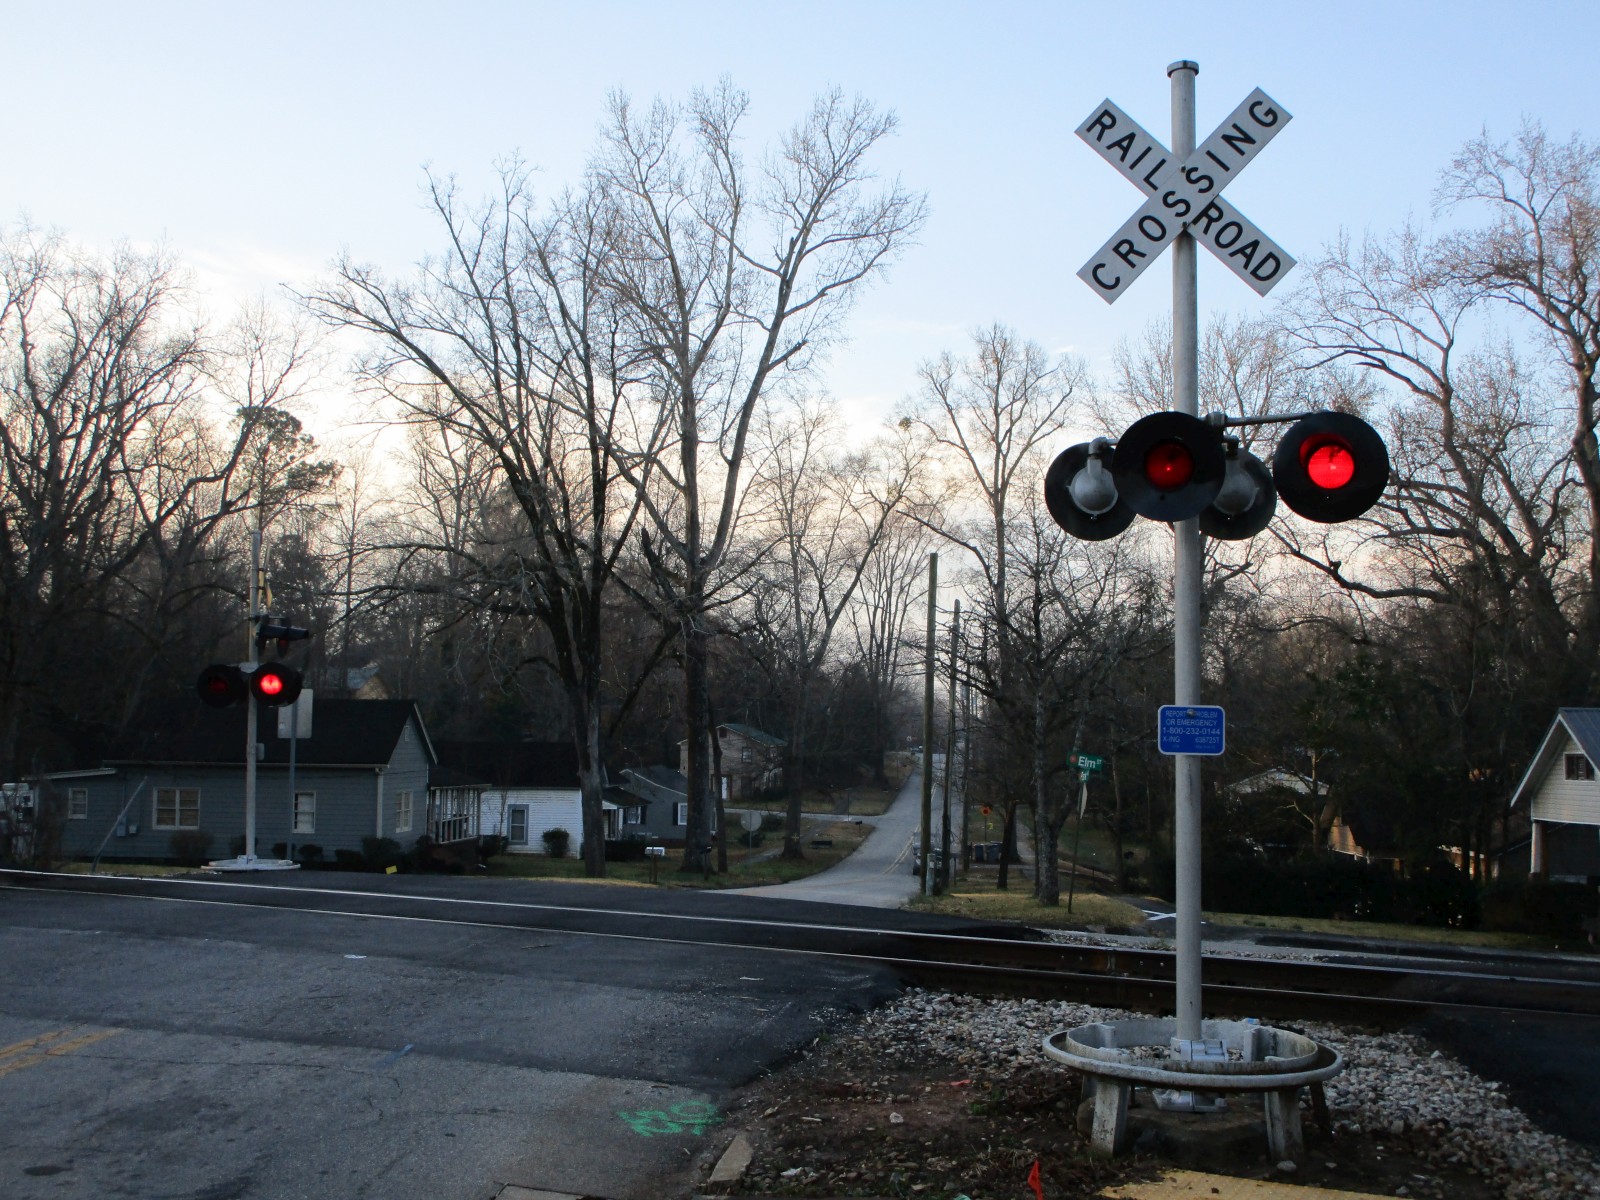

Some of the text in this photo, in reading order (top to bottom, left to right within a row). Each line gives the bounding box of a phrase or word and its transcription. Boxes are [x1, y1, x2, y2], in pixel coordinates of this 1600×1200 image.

[1086, 109, 1281, 282] RAIL ROAD
[1091, 100, 1278, 291] CROSSING
[1195, 711, 1218, 719] ROBLEM
[1163, 727, 1220, 735] 1-800-232-0144
[1163, 735, 1180, 743] X-ING
[1078, 756, 1095, 769] Elm
